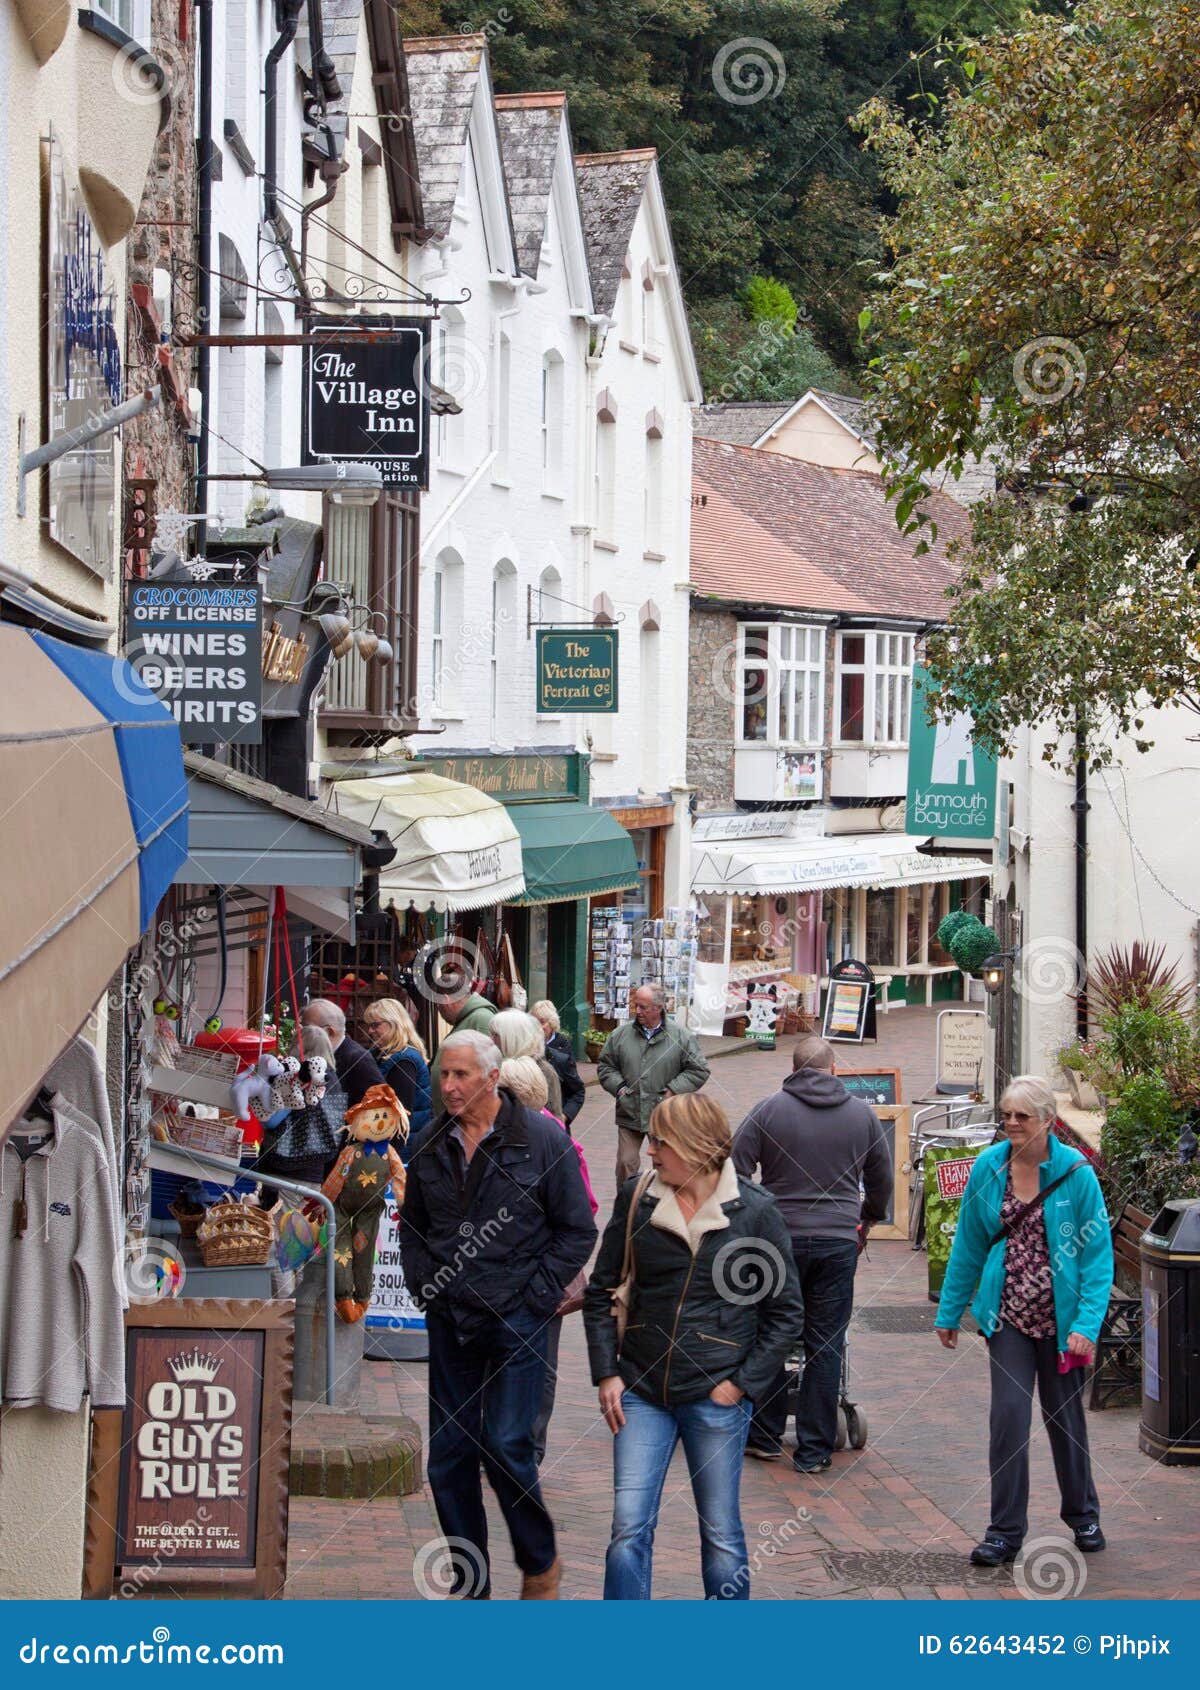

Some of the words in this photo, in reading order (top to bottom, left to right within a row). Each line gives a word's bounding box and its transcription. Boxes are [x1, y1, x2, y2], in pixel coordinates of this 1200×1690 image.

[313, 353, 355, 377] The
[316, 381, 416, 409] Village
[365, 410, 415, 432] Inn
[133, 588, 258, 607] CROCOMBES
[134, 607, 169, 620] OFF
[176, 607, 257, 621] LICENSE
[142, 633, 247, 656] WINES
[565, 642, 590, 658] The
[142, 666, 247, 690] BEERS
[544, 663, 612, 679] Victorian
[543, 684, 590, 698] Portrait
[160, 701, 257, 723] IRITS
[915, 789, 987, 811] lynmouth
[914, 806, 948, 829] bay
[949, 809, 986, 826] café
[148, 1382, 237, 1421] OLD
[138, 1421, 243, 1460] GUYS
[140, 1461, 243, 1499] RULE
[136, 1525, 159, 1536] THE
[160, 1526, 196, 1537] OLDER
[198, 1526, 205, 1537] I
[134, 1538, 157, 1549] THE
[160, 1538, 203, 1549] BETTER
[205, 1539, 213, 1549] I
[216, 1539, 240, 1550] WAS
